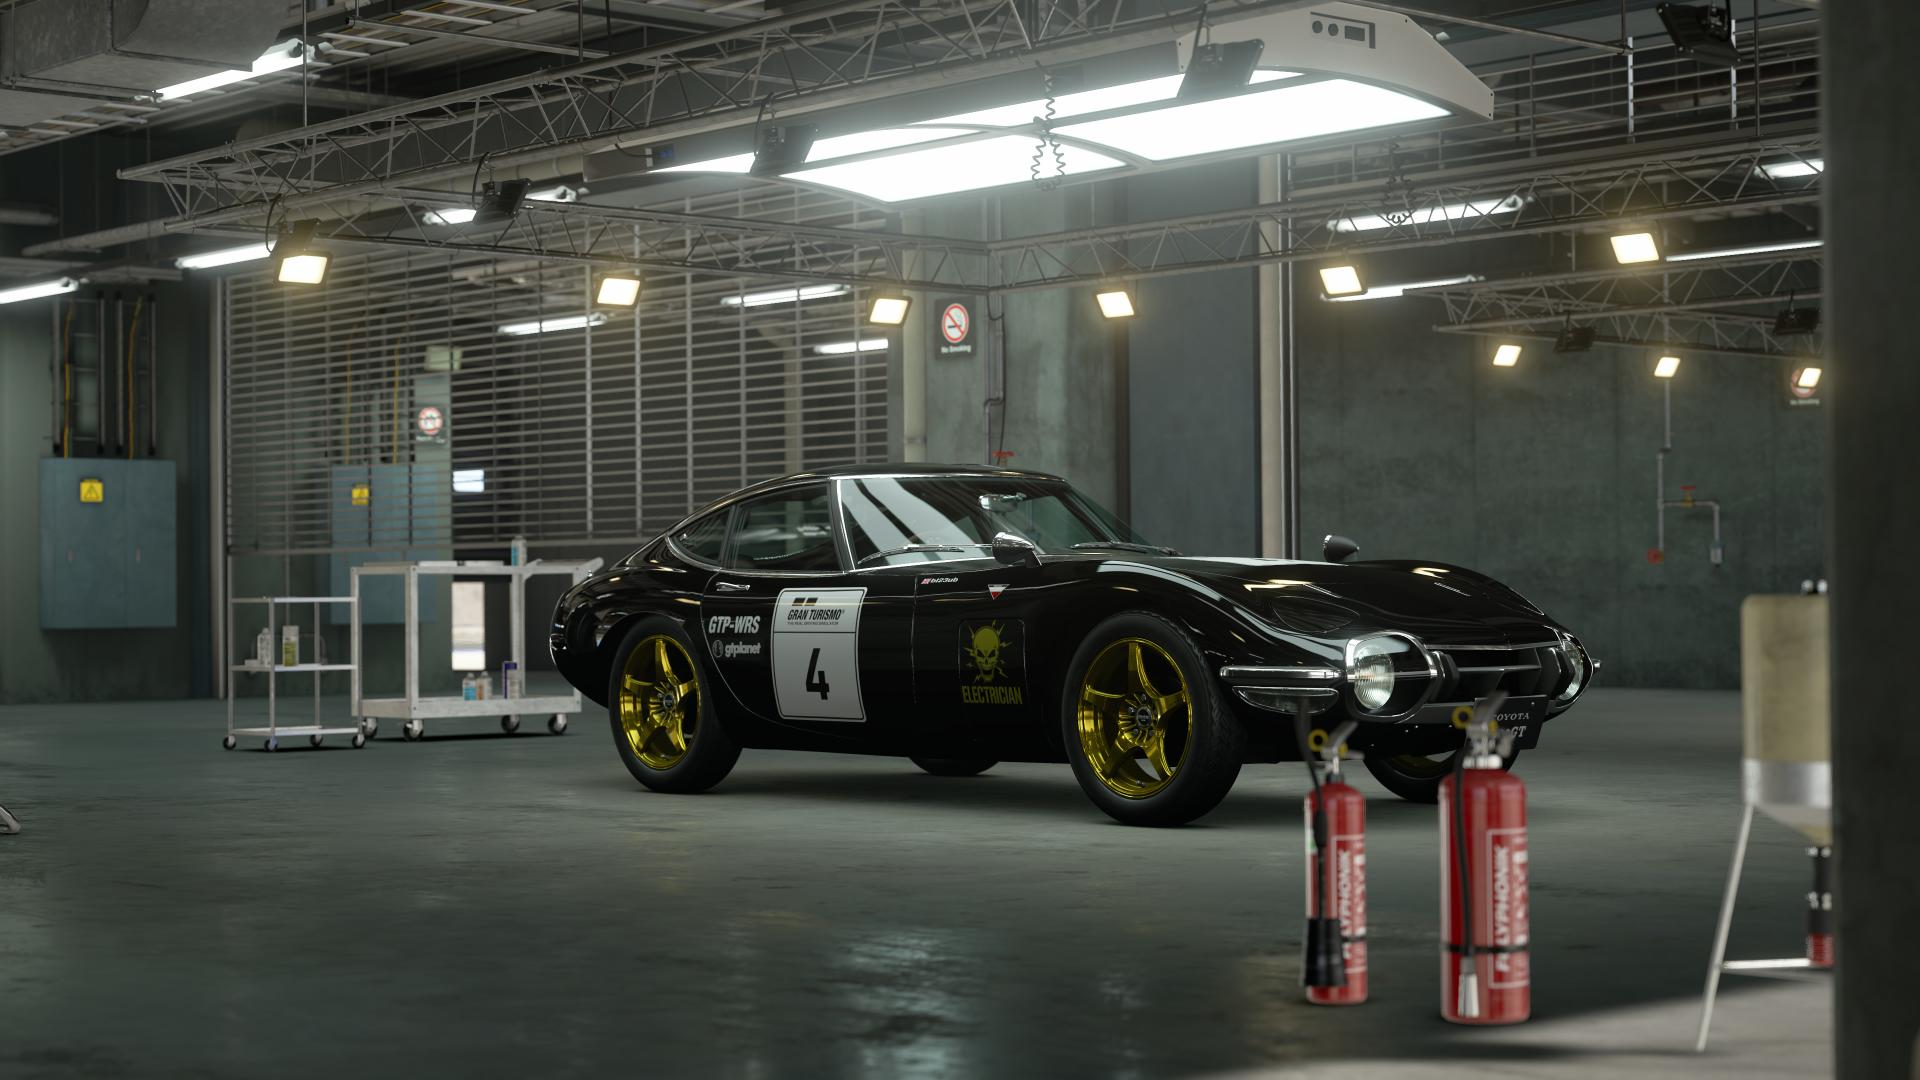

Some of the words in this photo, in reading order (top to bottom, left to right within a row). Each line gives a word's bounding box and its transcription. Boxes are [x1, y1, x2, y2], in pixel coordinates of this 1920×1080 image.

[787, 609, 809, 621] GRAN
[708, 615, 761, 634] GTP-WRS
[725, 641, 761, 658] gtplanet
[805, 647, 830, 700] 4
[961, 685, 1023, 704] ELECTRICIAN
[1494, 712, 1530, 722] OYOTA
